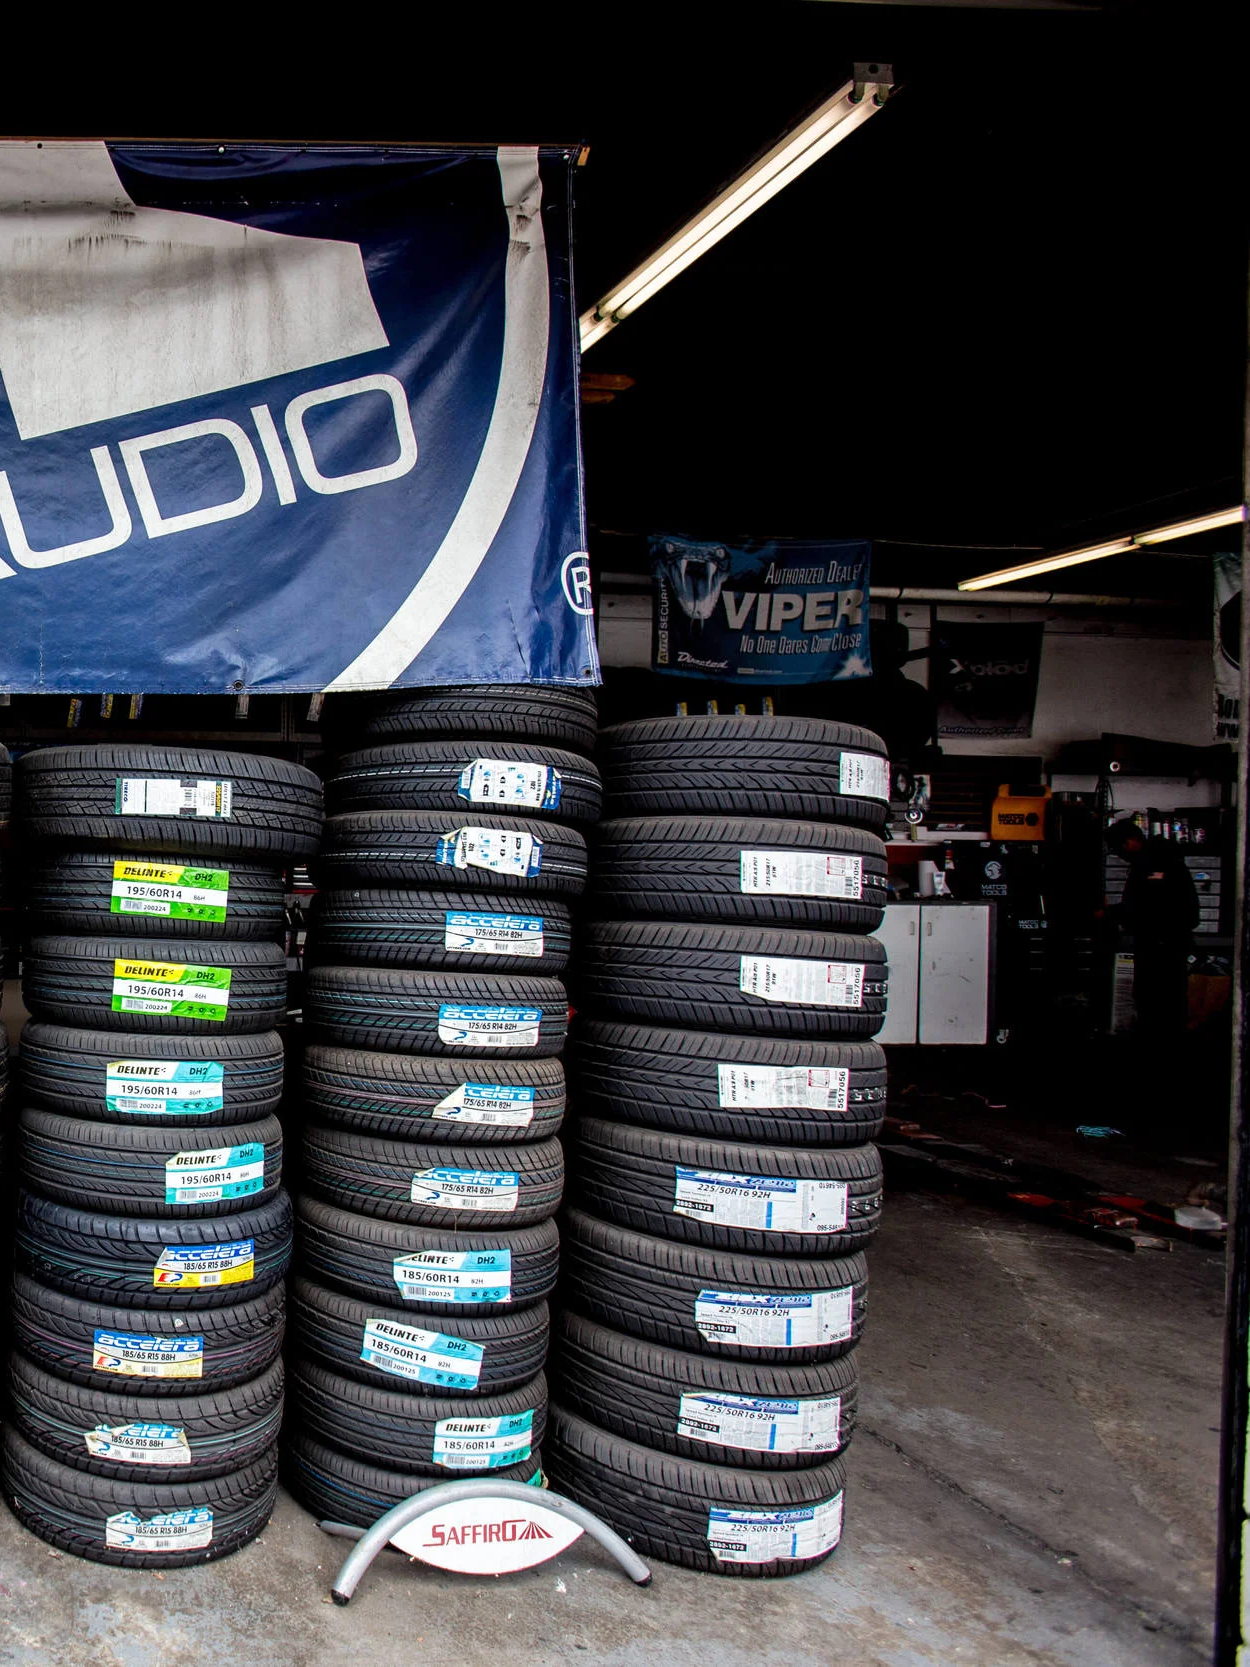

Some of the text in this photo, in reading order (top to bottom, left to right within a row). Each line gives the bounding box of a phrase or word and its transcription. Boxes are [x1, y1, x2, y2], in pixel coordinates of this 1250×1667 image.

[765, 562, 824, 584] AUTHORIZED
[722, 589, 863, 631] VIPER
[658, 578, 669, 663] AUTO SECURITY
[739, 635, 755, 652] No
[757, 634, 775, 653] One
[778, 636, 808, 654] Dares
[831, 632, 862, 650] Close
[124, 867, 214, 882] DELINTE DH2
[126, 885, 183, 899] 195/60R14
[450, 915, 540, 931] accelera
[475, 928, 523, 939] 175/65 R14 82H
[124, 965, 215, 980] DELINTE DH2
[128, 984, 184, 998] 195/60R14
[853, 967, 861, 1004] 5517056
[443, 1006, 538, 1021] accelera
[468, 1022, 490, 1030] 175/65
[492, 1022, 503, 1030] R14
[117, 1065, 208, 1075] DELINTE DH2
[121, 1084, 178, 1095] 195/60R14
[837, 1071, 845, 1109] 5517056
[139, 1102, 163, 1110] 200224
[464, 1098, 512, 1109] 175/65 R14 82H
[176, 1149, 254, 1165] DELINTE DH2
[180, 1173, 232, 1185] 195/60R14
[442, 1183, 494, 1194] 175/65 R14 82H
[697, 1183, 749, 1197] 225/50R16
[751, 1190, 771, 1199] 92H
[183, 1259, 233, 1271] 185/65 R15 88H
[408, 1253, 449, 1265] ELINTE
[402, 1269, 460, 1284] 185/60R14
[719, 1305, 770, 1316] 225/50R16
[98, 1333, 199, 1351] accelera
[376, 1323, 467, 1351] DELINTE DH2
[122, 1350, 176, 1361] 185/65 R15 88H
[371, 1338, 427, 1363] 185/60R14
[393, 1364, 416, 1375] 200125
[704, 1403, 755, 1419] 225/50R16
[757, 1412, 776, 1421] 92H
[446, 1418, 523, 1432] DELINTE DH2
[111, 1435, 164, 1448] 185/65 R15 88H
[443, 1440, 495, 1450] 185/60R14
[135, 1525, 188, 1535] 185/65 R15 88H
[422, 1519, 527, 1547] SAFFIRO
[731, 1524, 795, 1532] 225/50R16 92H
